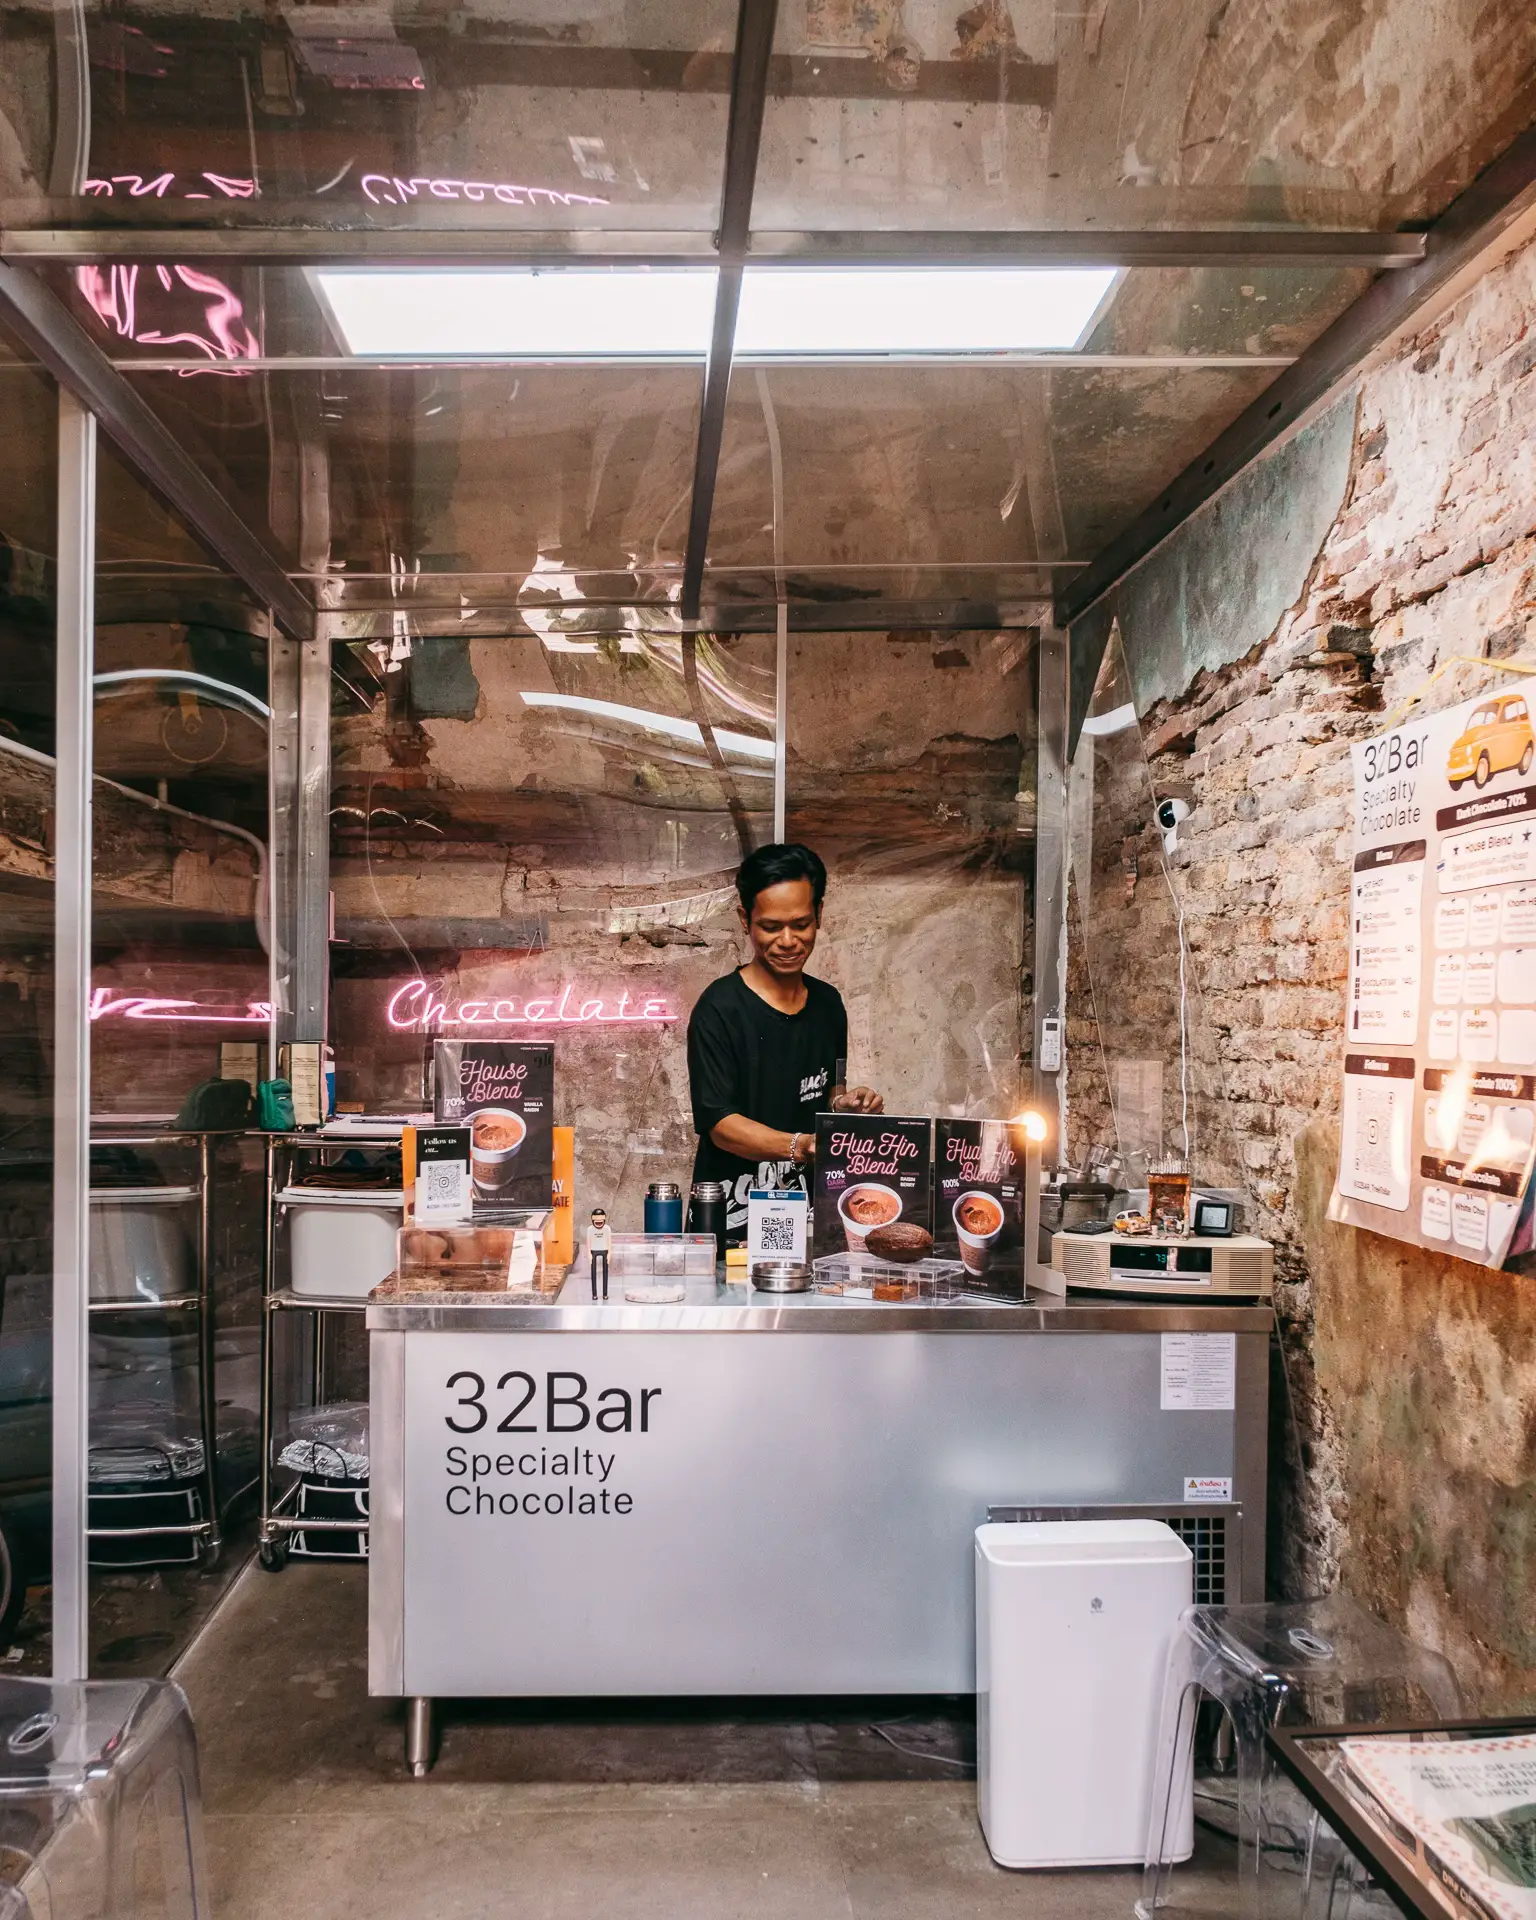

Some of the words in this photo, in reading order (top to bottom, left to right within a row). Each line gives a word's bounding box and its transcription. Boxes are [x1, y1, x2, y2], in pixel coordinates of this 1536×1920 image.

[1364, 734, 1429, 783] 32Bar
[1362, 780, 1416, 811] Specialty
[1472, 798, 1508, 816] Chocolate
[1507, 792, 1528, 808] 70%
[1361, 807, 1421, 836] Chocolate
[1488, 833, 1513, 849] Blend
[388, 980, 678, 1027] Chocolate
[460, 1059, 529, 1085] House
[467, 1081, 522, 1103] Blend
[1495, 1078, 1517, 1093] 100%
[444, 1096, 466, 1108] 70%
[830, 1132, 876, 1160] Hua
[878, 1132, 919, 1161] Hin
[946, 1138, 981, 1165] Hua
[825, 1170, 846, 1180] 70%
[846, 1154, 899, 1175] Blend
[959, 1162, 1001, 1184] Blend
[942, 1178, 960, 1188] 100%
[445, 1371, 662, 1434] 32Bar
[445, 1446, 616, 1483] Specialty
[446, 1486, 634, 1515] Chocolate
